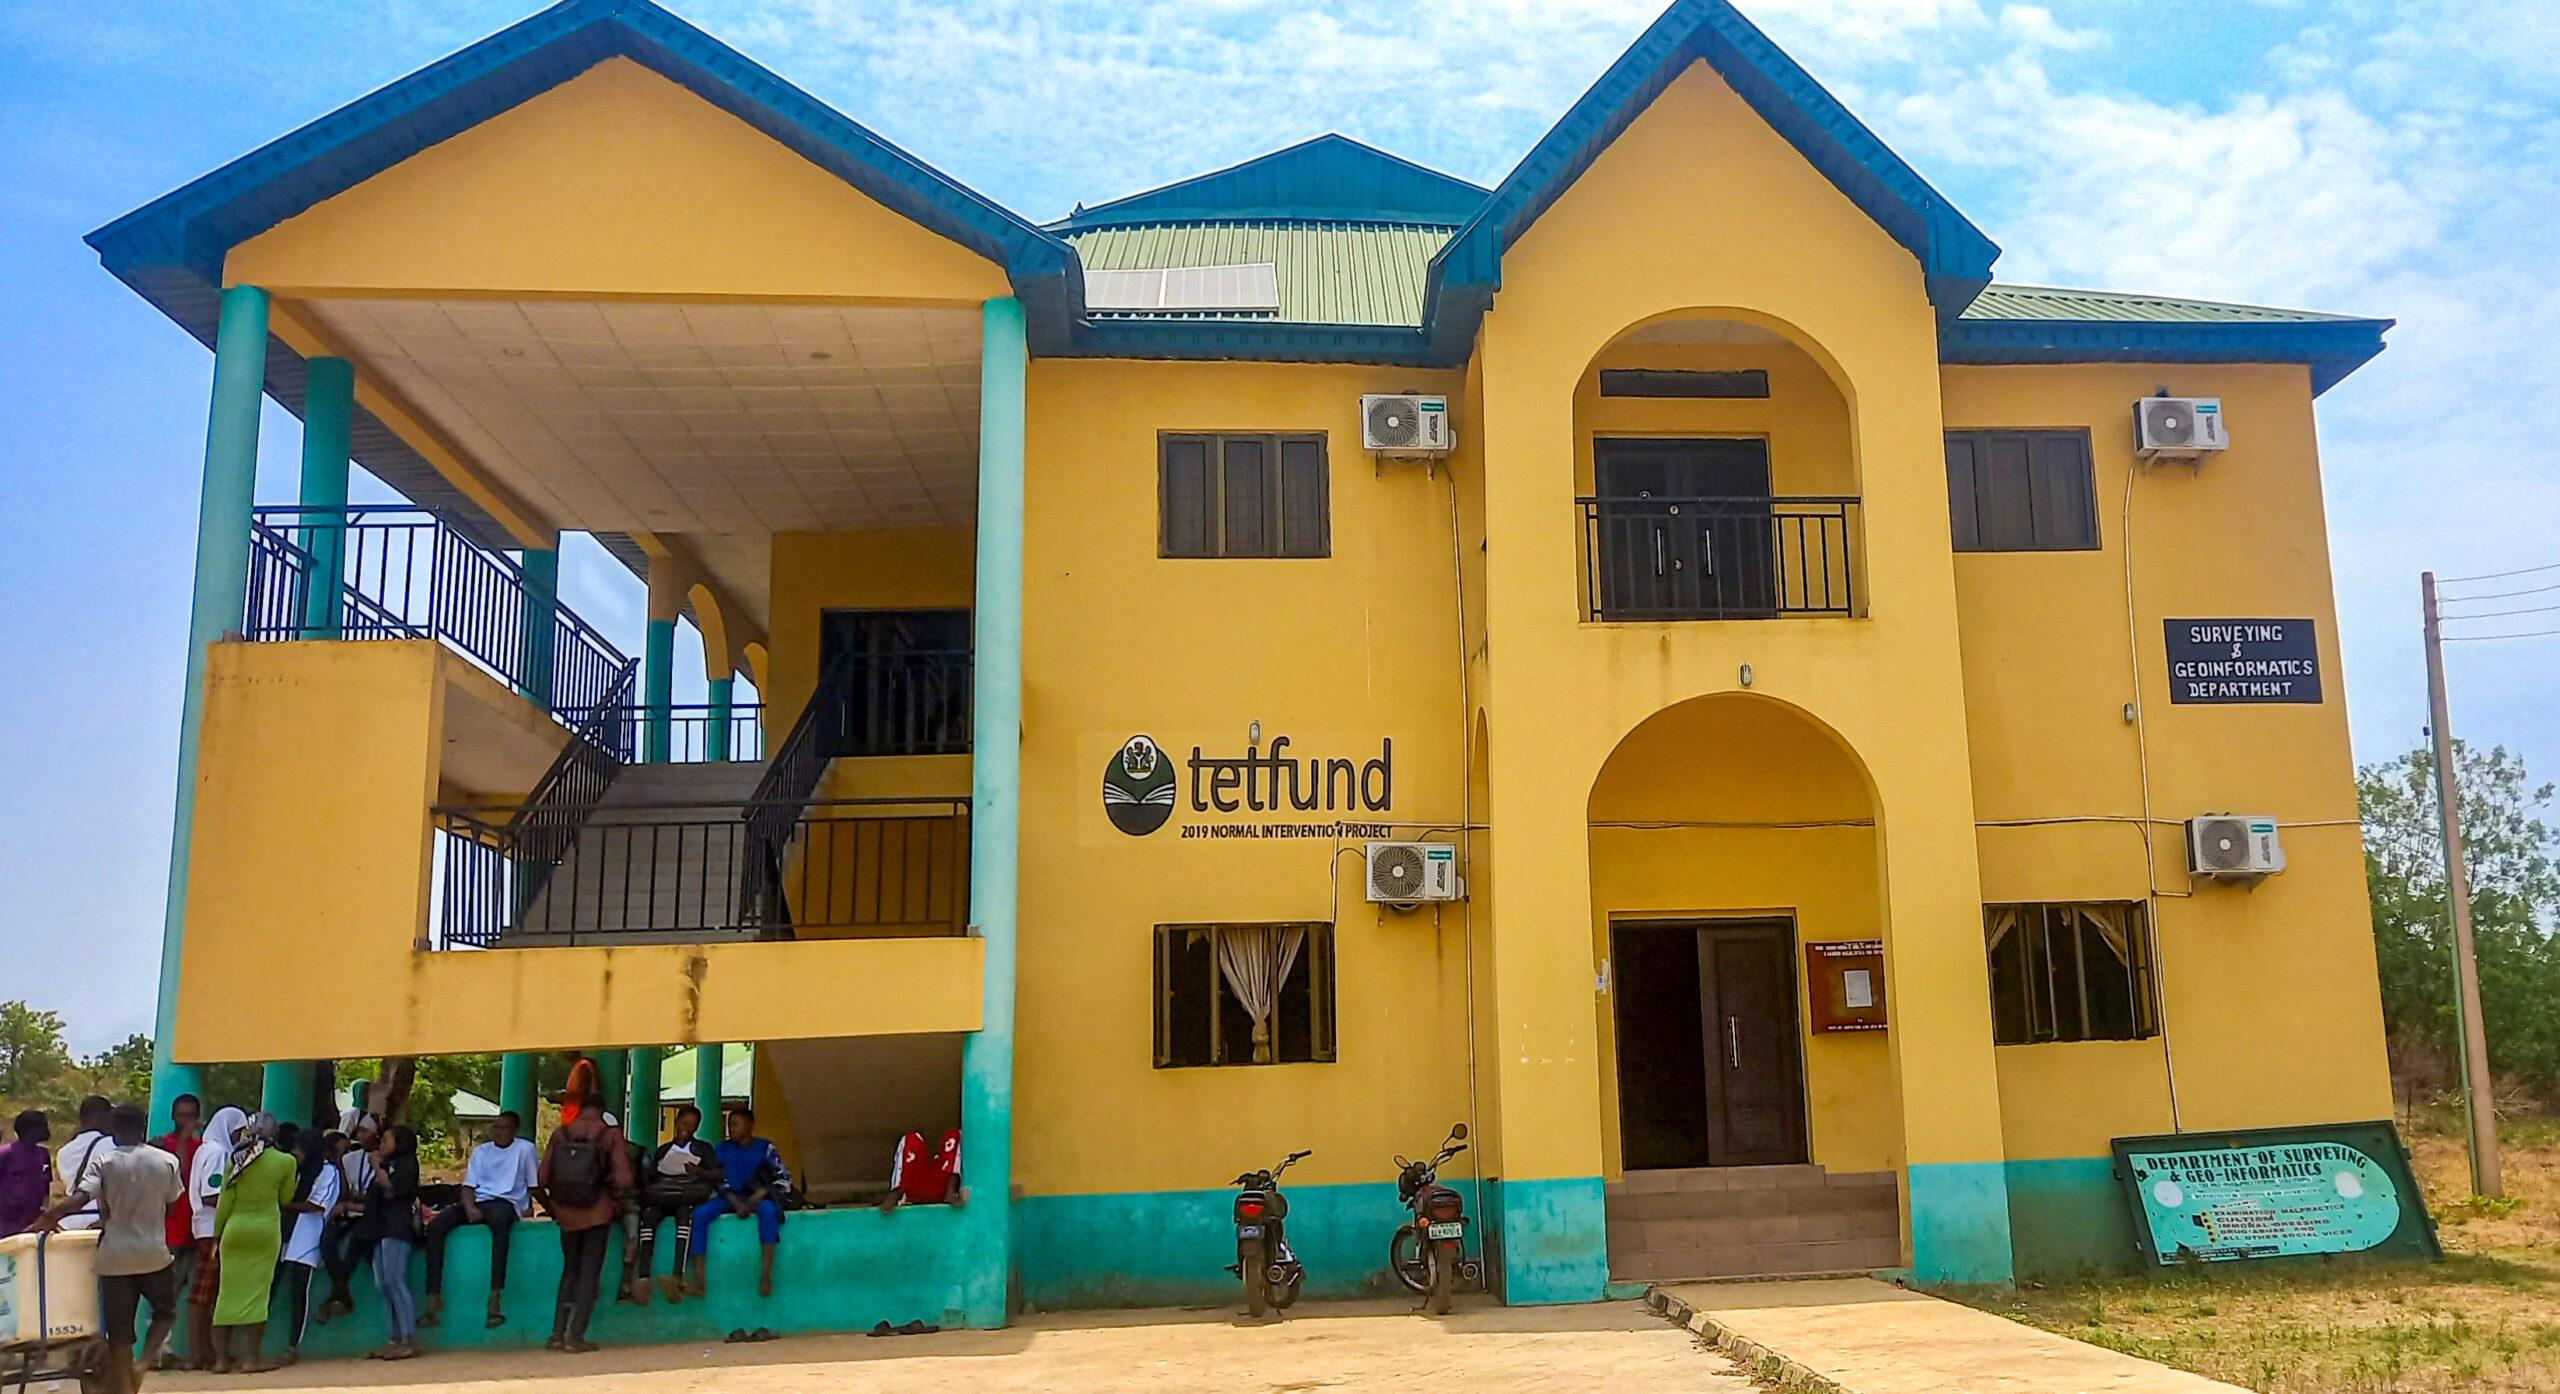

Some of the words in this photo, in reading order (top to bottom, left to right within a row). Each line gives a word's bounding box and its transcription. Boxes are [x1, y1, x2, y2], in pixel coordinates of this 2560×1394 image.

[2190, 625, 2283, 643] SURVEYING
[2230, 642, 2242, 659] &
[2174, 659, 2313, 678] GEOINFORMATICS
[2188, 681, 2293, 698] DEPARTMENT
[1187, 736, 1392, 812] tetfund
[1180, 825, 1208, 839] 2019
[1210, 824, 1260, 839] NORMAL
[1261, 824, 1343, 838] INTERVENTION
[1344, 824, 1393, 838] PROJECT
[2283, 1146, 2368, 1169] SURVEYING
[2169, 1170, 2182, 1183] &
[2185, 1162, 2322, 1183] GEO-INFORMATICS
[2213, 1209, 2276, 1217] EXAMINATION
[2280, 1203, 2346, 1214] MALPRACTICE
[2215, 1215, 2275, 1223] CULTISM
[2321, 1228, 2354, 1237] VICES
